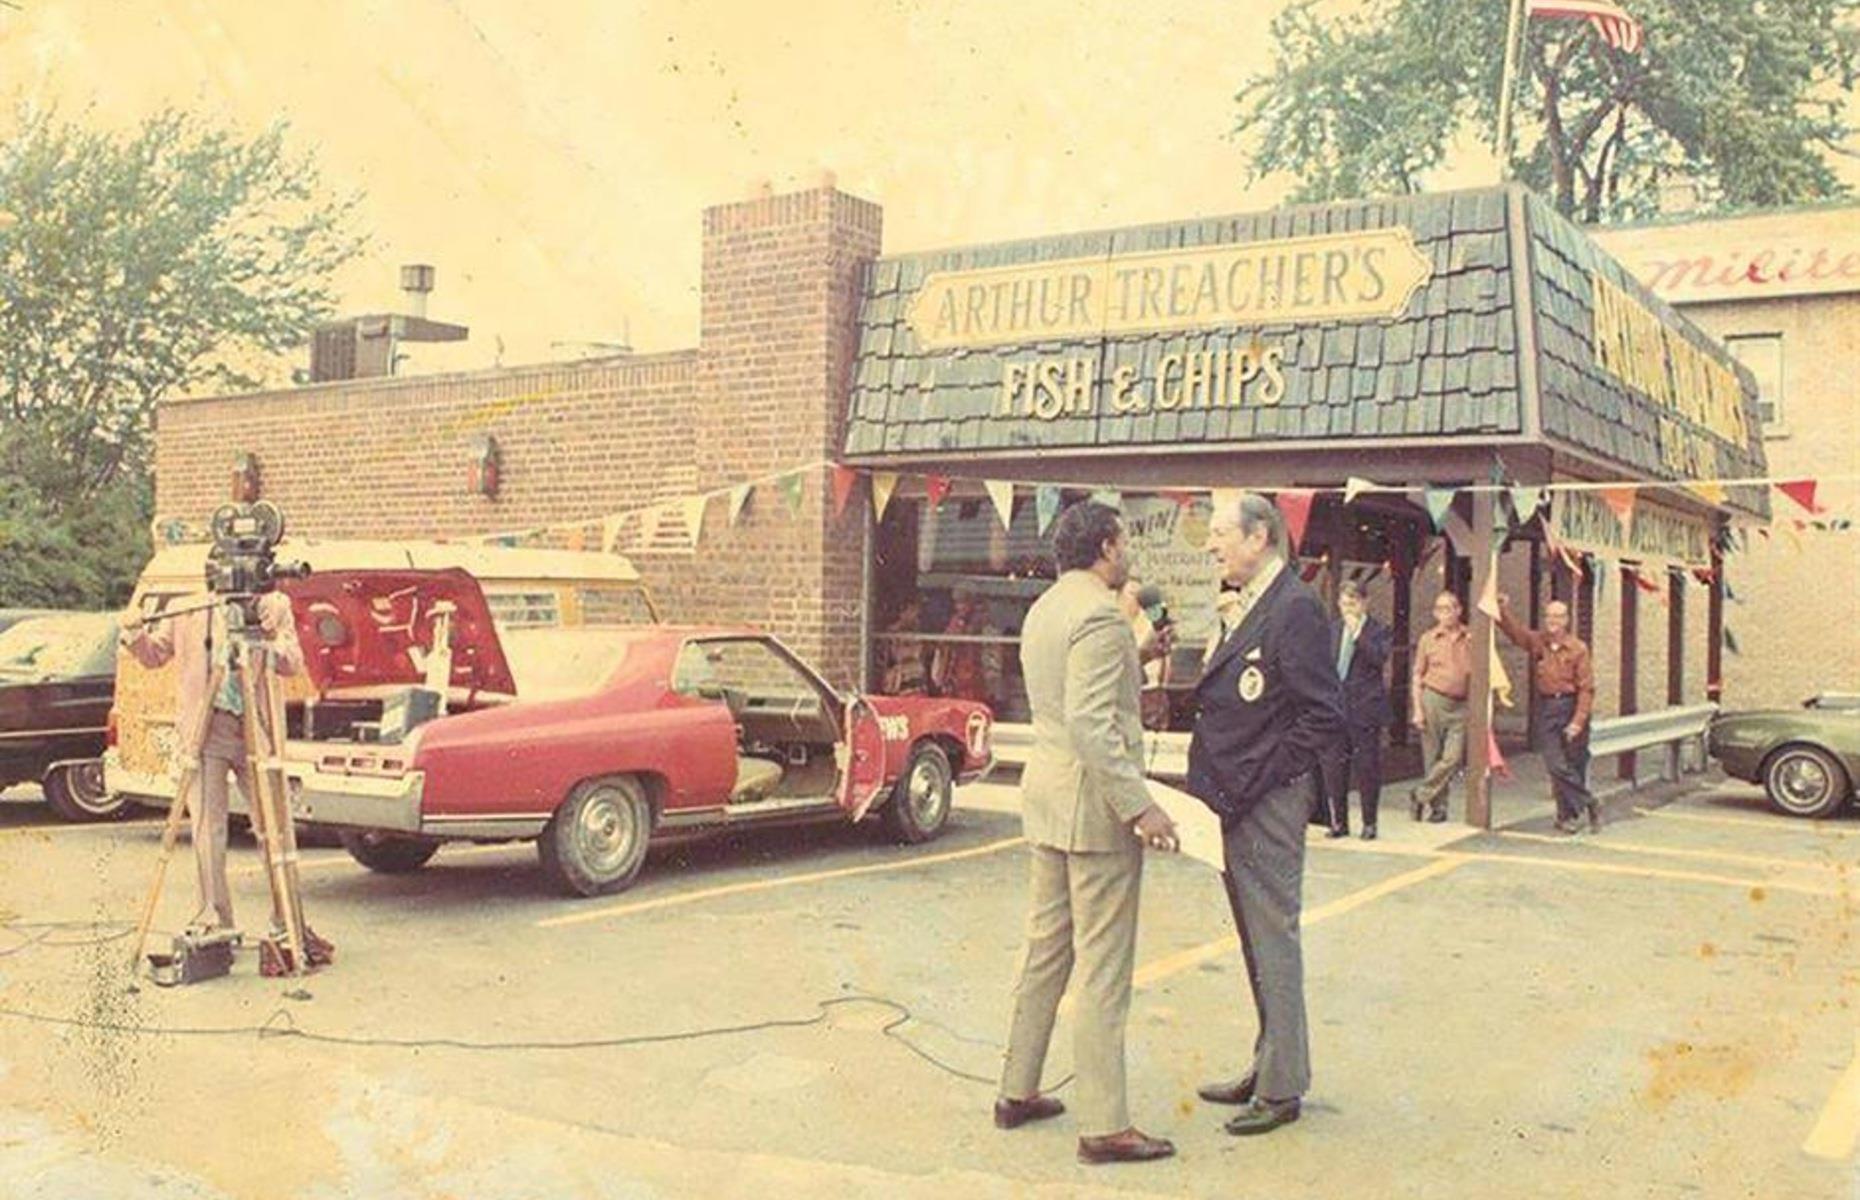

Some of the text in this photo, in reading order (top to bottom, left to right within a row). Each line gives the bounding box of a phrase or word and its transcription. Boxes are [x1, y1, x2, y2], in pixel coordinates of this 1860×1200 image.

[934, 248, 1386, 338] ARTHUR TREACHER'S
[1001, 347, 1287, 420] FISH & CHIPS
